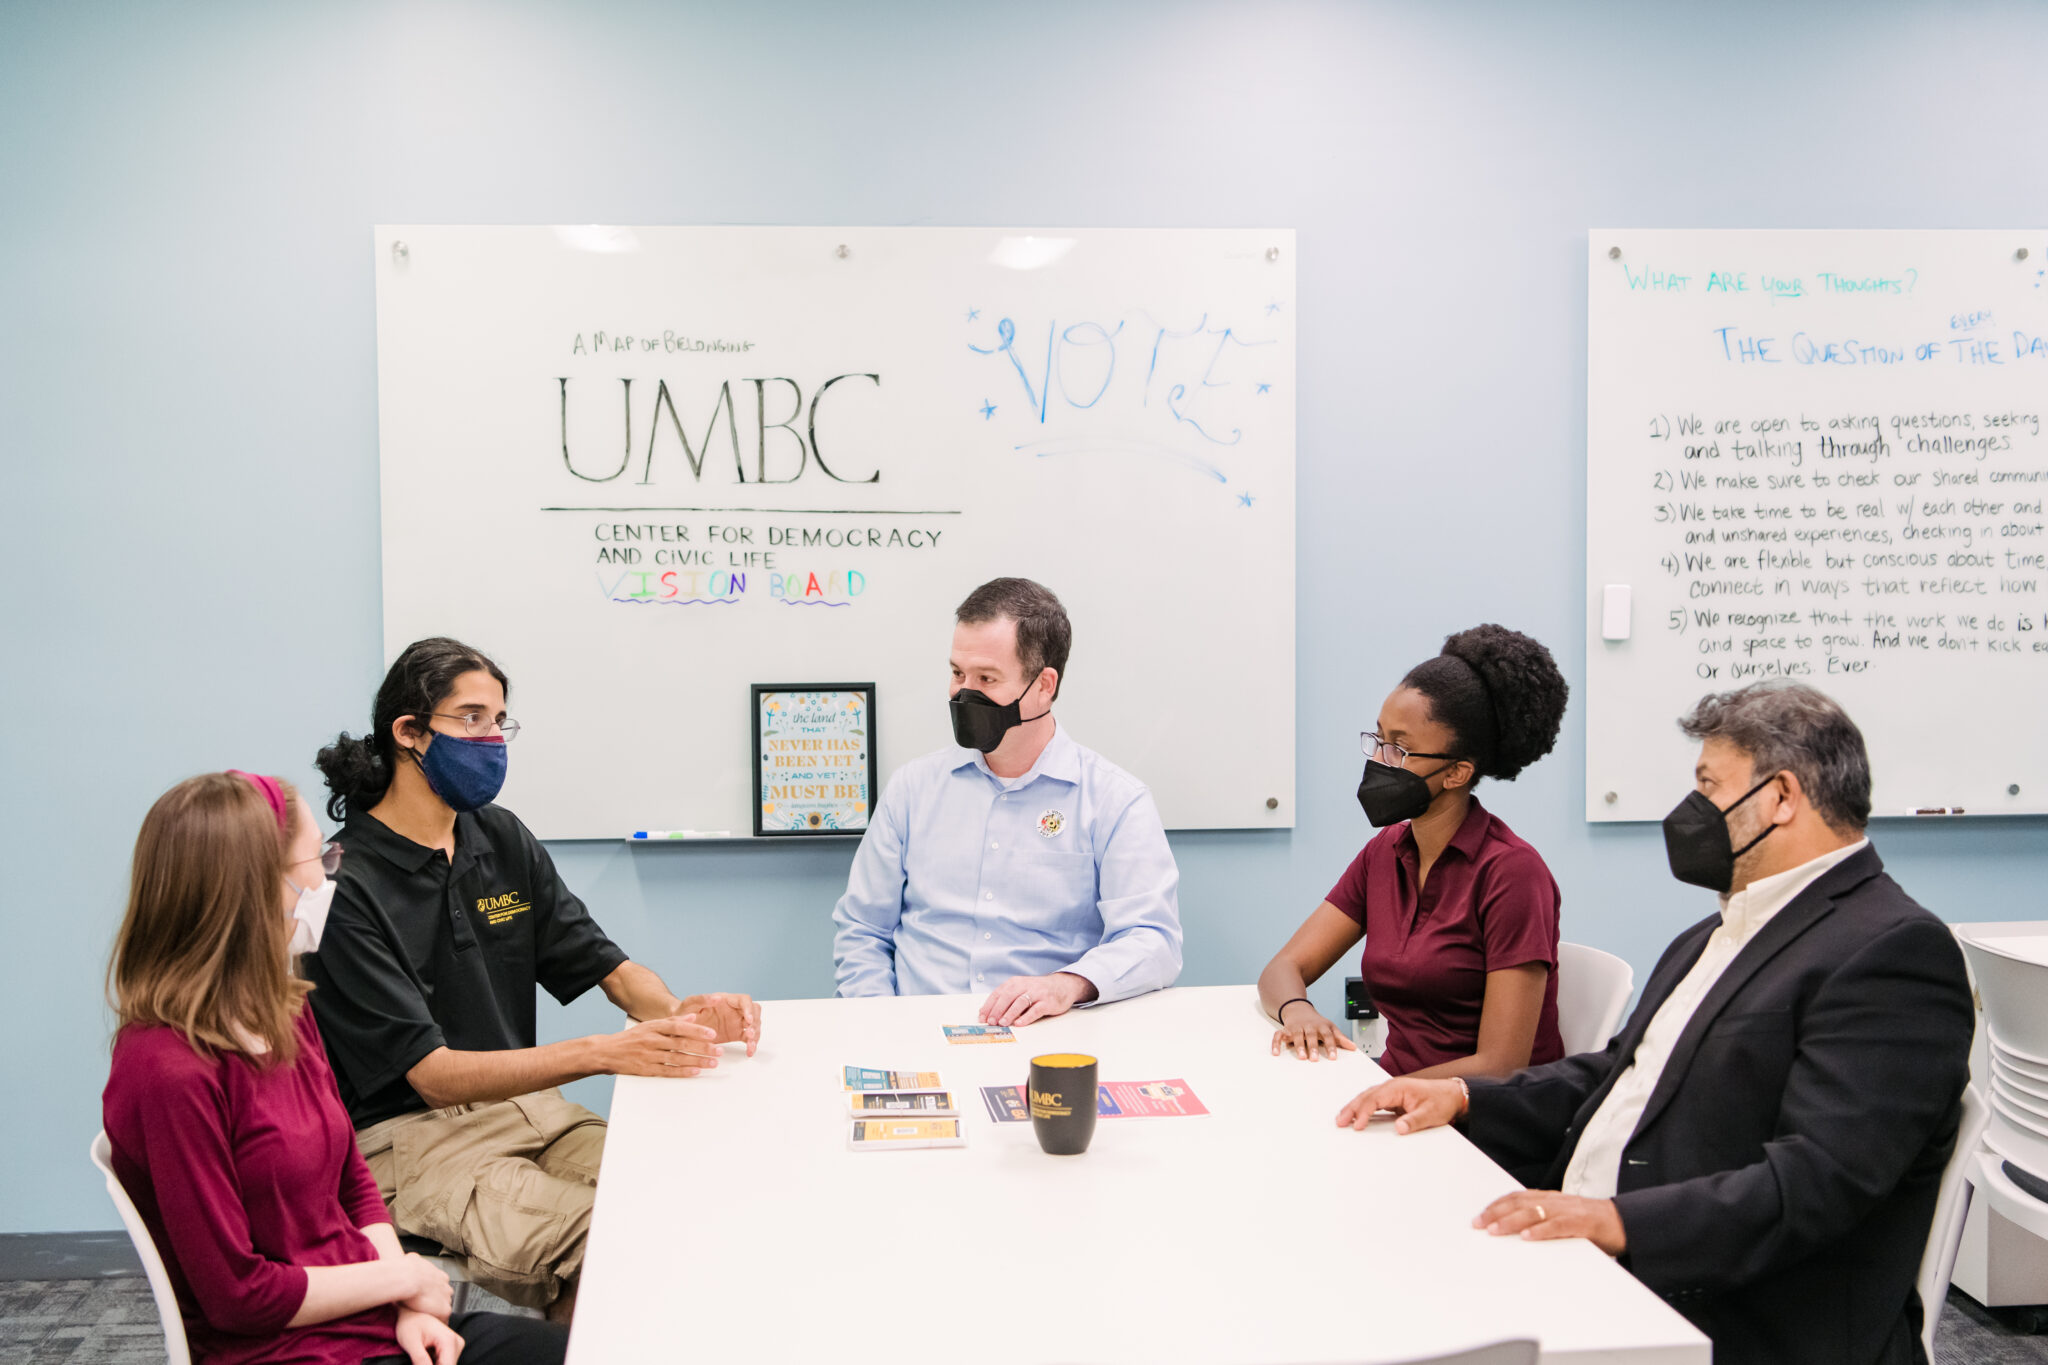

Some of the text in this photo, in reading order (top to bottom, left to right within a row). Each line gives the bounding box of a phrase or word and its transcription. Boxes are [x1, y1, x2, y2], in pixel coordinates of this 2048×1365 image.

[1624, 264, 1692, 292] WHAT
[1706, 272, 1751, 292] ARE
[573, 332, 587, 355] A
[641, 338, 660, 352] OF
[1713, 327, 1782, 363] THE
[1792, 331, 1904, 365] QUESTION
[1915, 341, 1941, 361] OF
[1948, 338, 2005, 365] THE
[968, 312, 1277, 446] VOTE
[553, 372, 881, 485] UMBC
[1678, 413, 1704, 436] We
[1714, 419, 1742, 435] are
[1751, 418, 1790, 439] open
[1800, 413, 1820, 431] to
[1828, 412, 1881, 438] asking
[1890, 411, 1975, 439] questions,
[1983, 411, 2039, 436] seeking
[1684, 440, 1720, 459] and
[1731, 440, 1803, 467] talking
[1817, 435, 1891, 463] through
[1653, 470, 1674, 492] 2)
[1680, 470, 1707, 490] We
[1716, 472, 1760, 489] make
[1767, 474, 1805, 490] sure
[1812, 469, 1831, 487] to
[1837, 470, 1880, 486] check
[1893, 471, 1922, 486] our
[1989, 470, 2048, 483] communi
[1654, 495, 2043, 524] 3) We take time to be real w/ each other and
[595, 523, 943, 549] CENTER FOR DEMOCRACY
[1685, 522, 2044, 548] and unshared experiences, checking in about
[596, 546, 642, 565] AND
[729, 551, 776, 569] LIFE
[1685, 551, 1716, 572] We
[1724, 555, 1750, 569] are
[1758, 549, 1812, 570] flexible
[1825, 551, 1855, 568] but
[1863, 553, 1938, 568] conscious
[1947, 550, 1995, 567] about
[595, 569, 866, 599] VISION BOARD
[1774, 578, 1791, 596] in
[1802, 580, 1850, 599] ways
[1861, 575, 1911, 597] that
[1919, 576, 1988, 595] reflect
[2000, 576, 2037, 594] how
[1668, 605, 1688, 635] 5)
[1694, 608, 1720, 627] We
[1727, 610, 1801, 634] recognize
[1808, 609, 1852, 627] that
[1863, 610, 1897, 628] the
[1906, 611, 1946, 628] work
[1957, 614, 1979, 630] we
[1987, 614, 2006, 631] do
[2017, 613, 2034, 631] is
[1698, 635, 1732, 654] and
[1743, 635, 1786, 657] space
[1794, 634, 1813, 649] to
[1872, 630, 1901, 649] And
[1907, 634, 1930, 649] we
[793, 711, 837, 723] the land
[768, 738, 861, 751] NEVER HAS
[774, 754, 855, 767] BEEN YET
[770, 784, 860, 800] MUST BE
[485, 891, 520, 910] UMBC
